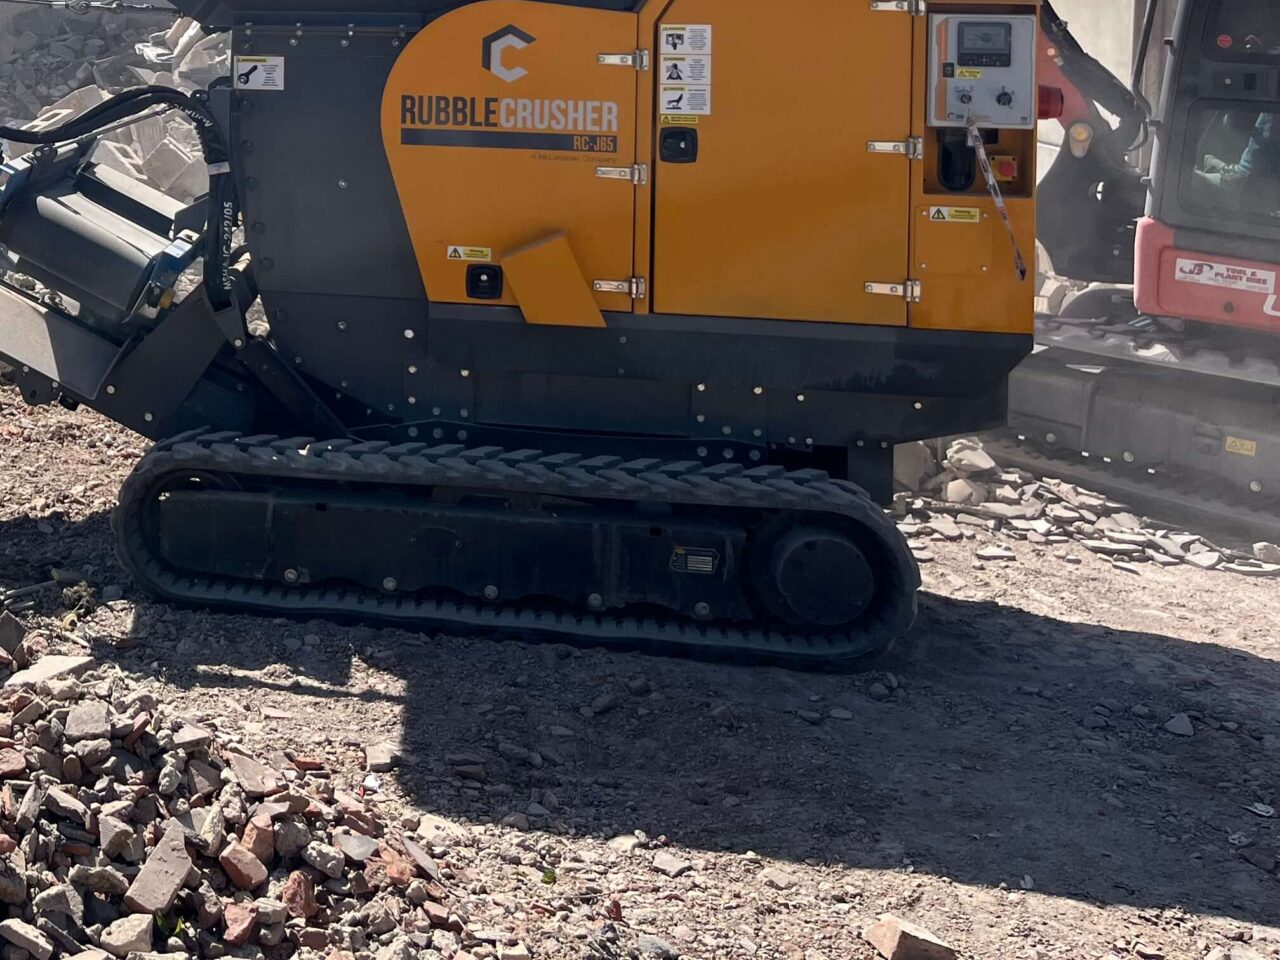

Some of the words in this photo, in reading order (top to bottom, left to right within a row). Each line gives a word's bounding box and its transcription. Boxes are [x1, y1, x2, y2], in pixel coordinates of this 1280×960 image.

[400, 94, 618, 132] RUBBLECRUSHER
[573, 135, 614, 152] RC-J65
[1214, 272, 1243, 281] PLANT
[1225, 267, 1247, 276] TOOL
